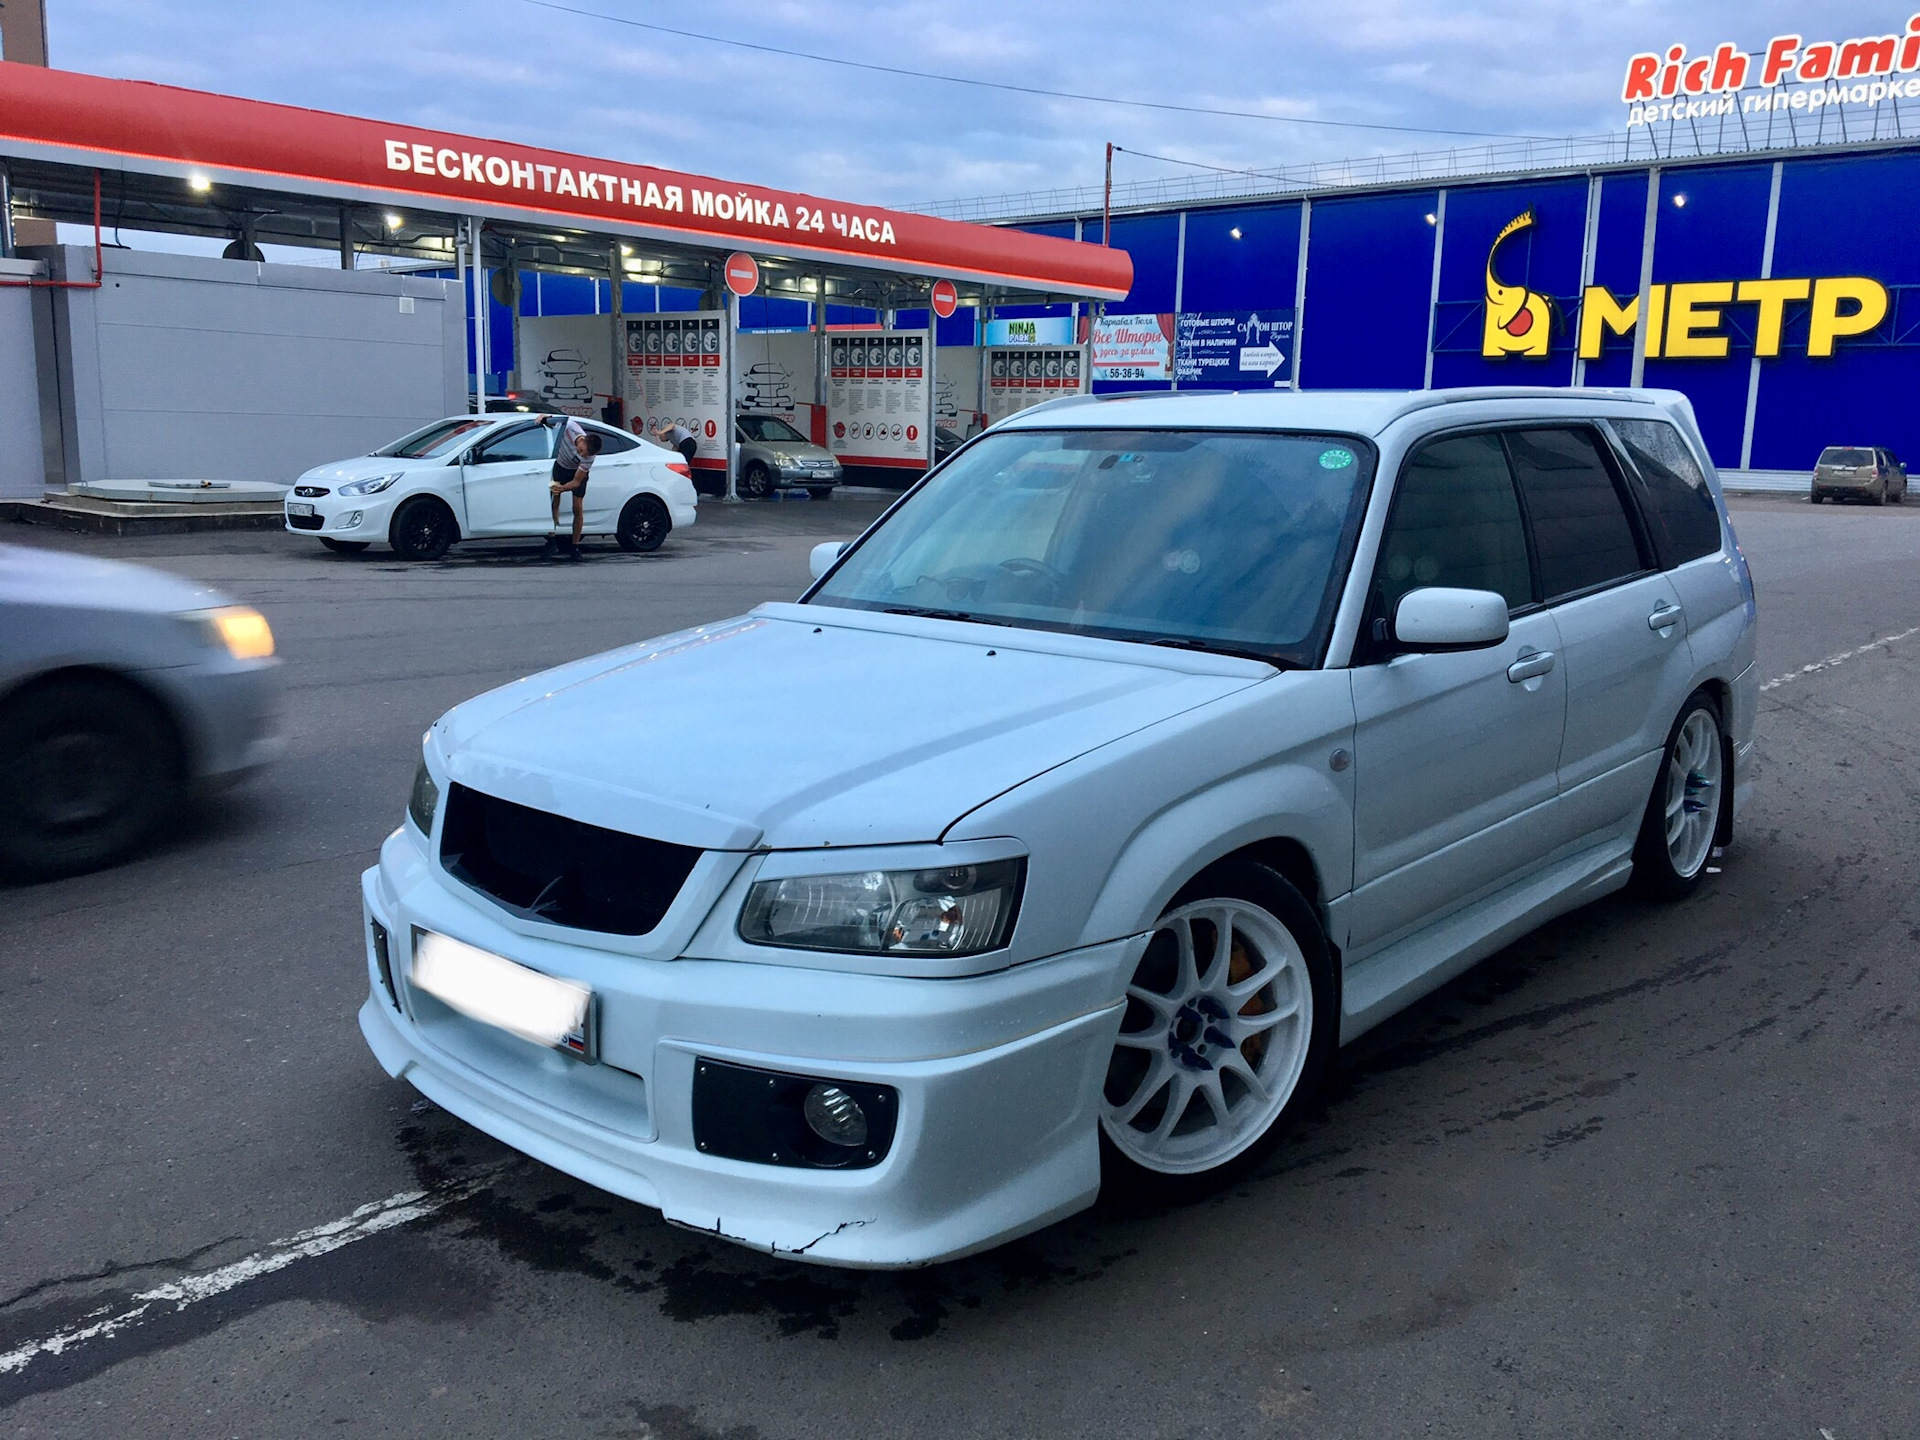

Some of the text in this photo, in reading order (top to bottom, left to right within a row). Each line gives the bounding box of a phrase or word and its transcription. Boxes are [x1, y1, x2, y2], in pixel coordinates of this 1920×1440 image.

[1621, 42, 1750, 103] Rich
[1626, 93, 1734, 128] детский
[385, 139, 897, 245] БЕСКОНТАКТНАЯ МОЙКА 24 ЧАСА
[1180, 318, 1235, 327] ГОТОВЫЕ ШТОРЫ
[1578, 277, 1891, 360] МЕТР
[1009, 322, 1036, 334] NINJA
[1271, 321, 1293, 331] ШТОР
[1009, 333, 1029, 343] PARK
[1093, 328, 1163, 347] Все Шторы
[1180, 338, 1237, 347] ТКАНИ В НАЛИЧИИ
[1120, 348, 1129, 358] за
[1177, 358, 1230, 367] ТКАНИ ТУРЕЦКИХ
[1109, 368, 1145, 379] 56-36-94
[1176, 367, 1203, 376] ФАБРИК
